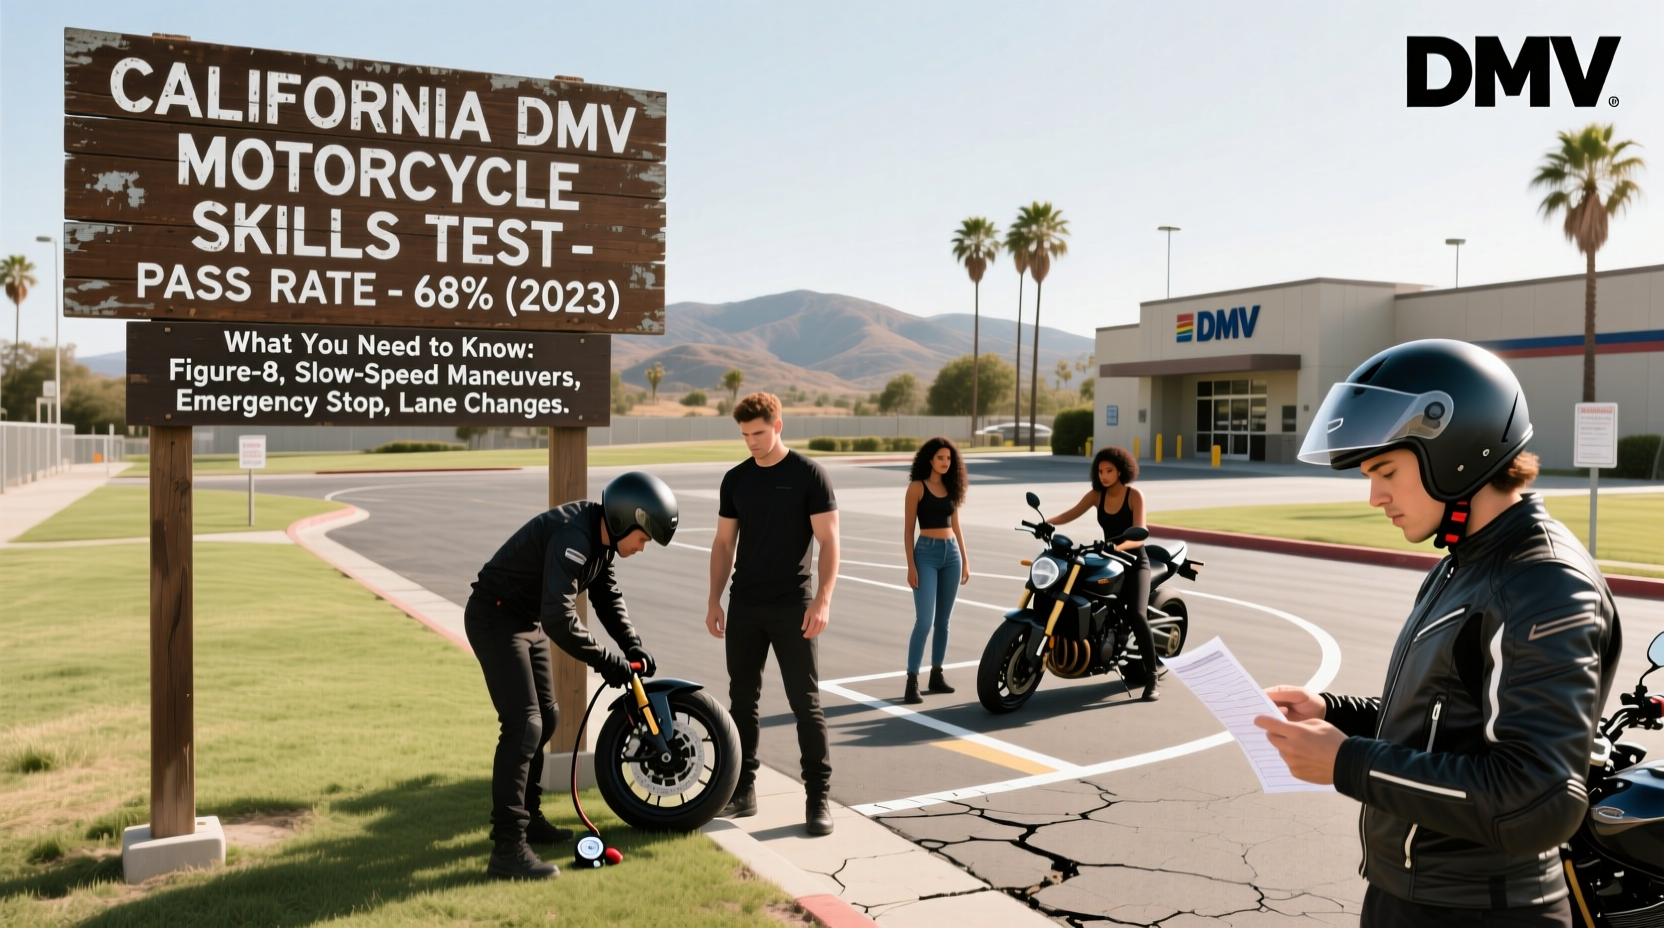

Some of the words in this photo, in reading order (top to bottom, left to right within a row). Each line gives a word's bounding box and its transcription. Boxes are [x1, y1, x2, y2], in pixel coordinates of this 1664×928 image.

[110, 57, 492, 142] CALIFORNIA
[517, 96, 637, 154] DMV
[178, 133, 581, 211] MOTORCYCLE
[191, 200, 400, 260] SKILLS
[137, 262, 252, 302] PASS
[270, 268, 377, 306] RATE
[414, 274, 494, 310] 68%
[506, 275, 621, 320] (2023)
[223, 330, 293, 355] What
[301, 332, 348, 355] You
[358, 334, 420, 357] Need
[429, 336, 454, 358] to
[462, 336, 535, 359] Know:
[1197, 304, 1261, 342] DMV
[169, 358, 286, 386] Figure-8,
[295, 361, 439, 390] Slow-Speed
[448, 364, 582, 392] Maneuvers,
[176, 388, 318, 419] Emergency
[326, 390, 392, 420] Stop,
[399, 391, 457, 414] Lane
[464, 392, 571, 420] Changes.
